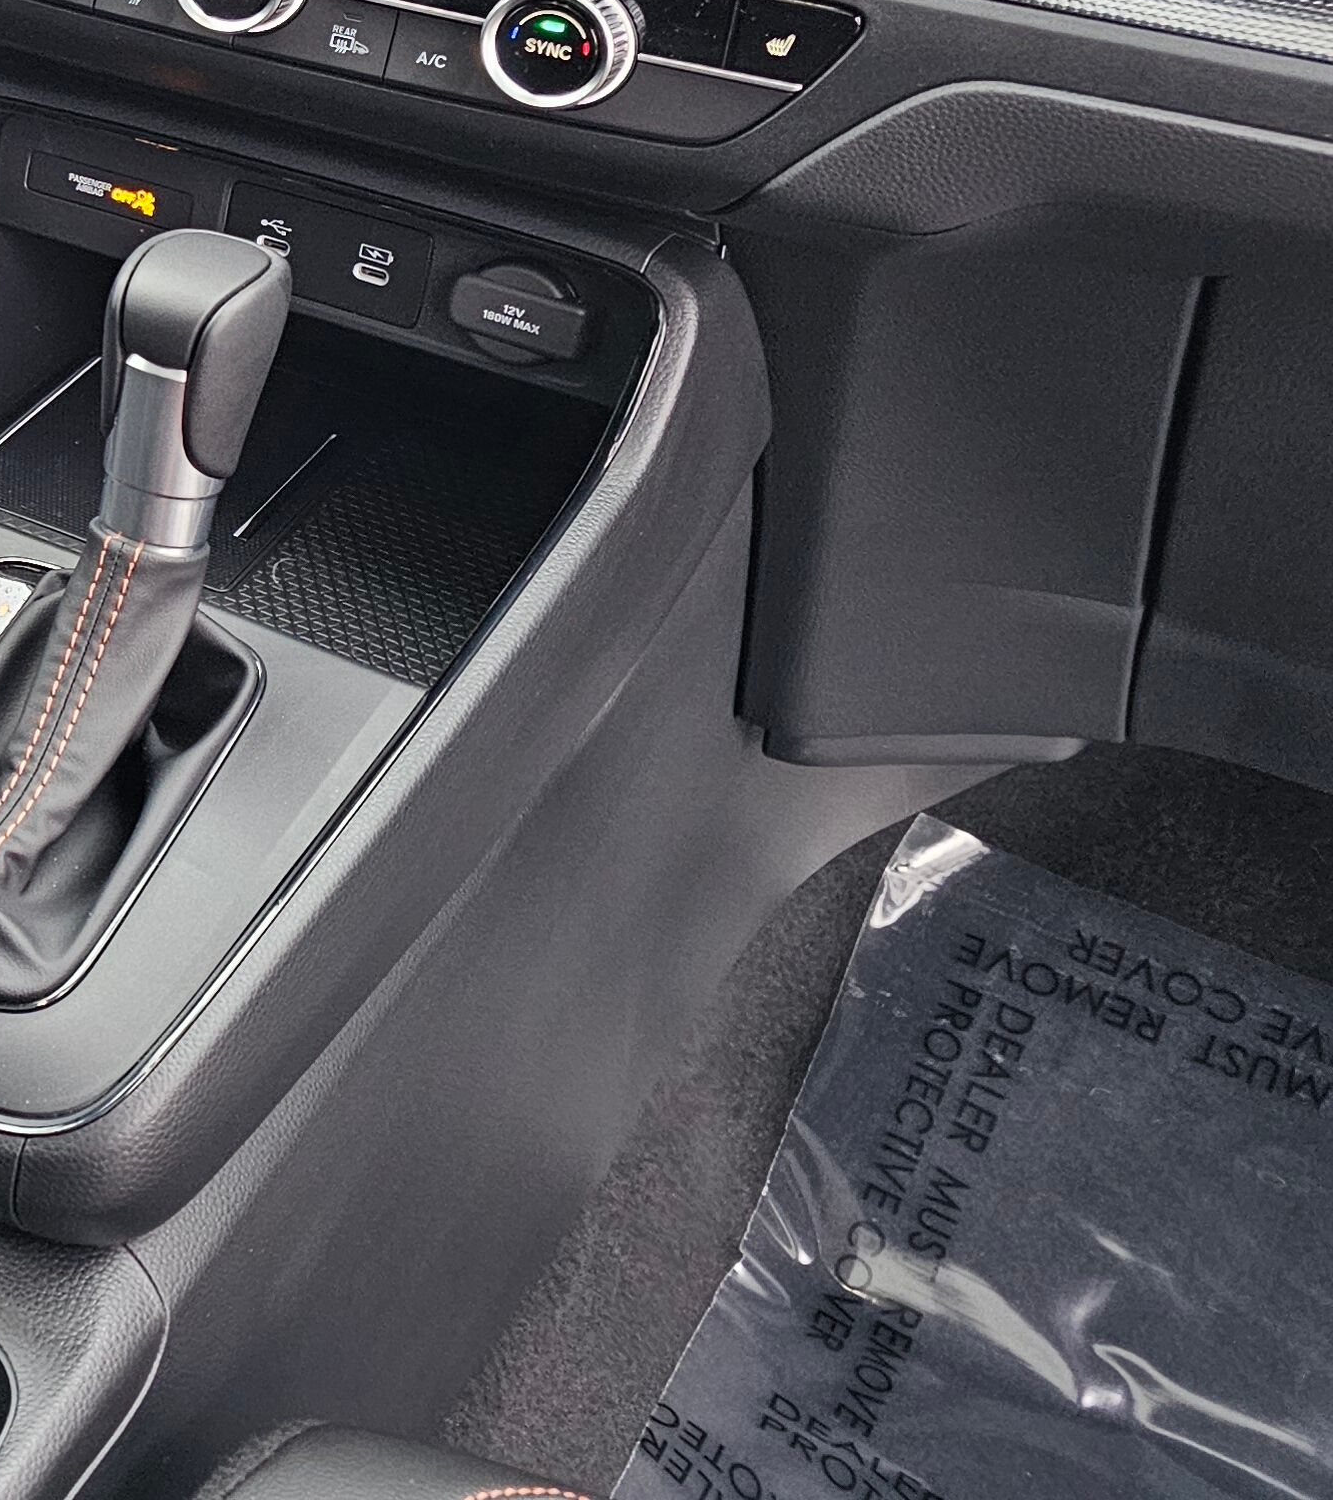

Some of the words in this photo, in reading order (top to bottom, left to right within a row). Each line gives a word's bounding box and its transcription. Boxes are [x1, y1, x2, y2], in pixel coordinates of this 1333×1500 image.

[332, 24, 359, 38] REAR
[416, 51, 448, 70] A/C
[523, 37, 573, 62] SYNC
[68, 172, 113, 192] PASSENGER
[75, 182, 105, 198] AIRBAG
[482, 309, 513, 326] 180W
[513, 318, 541, 336] MAX
[503, 304, 526, 319] 12V
[953, 932, 1167, 1047] REMOVE
[1068, 929, 1246, 1024] COVER
[945, 1001, 1036, 1154] DEALER
[861, 979, 983, 1216] PROTECTIVE
[806, 1220, 886, 1353] COVER
[833, 1296, 924, 1439] REMOVE
